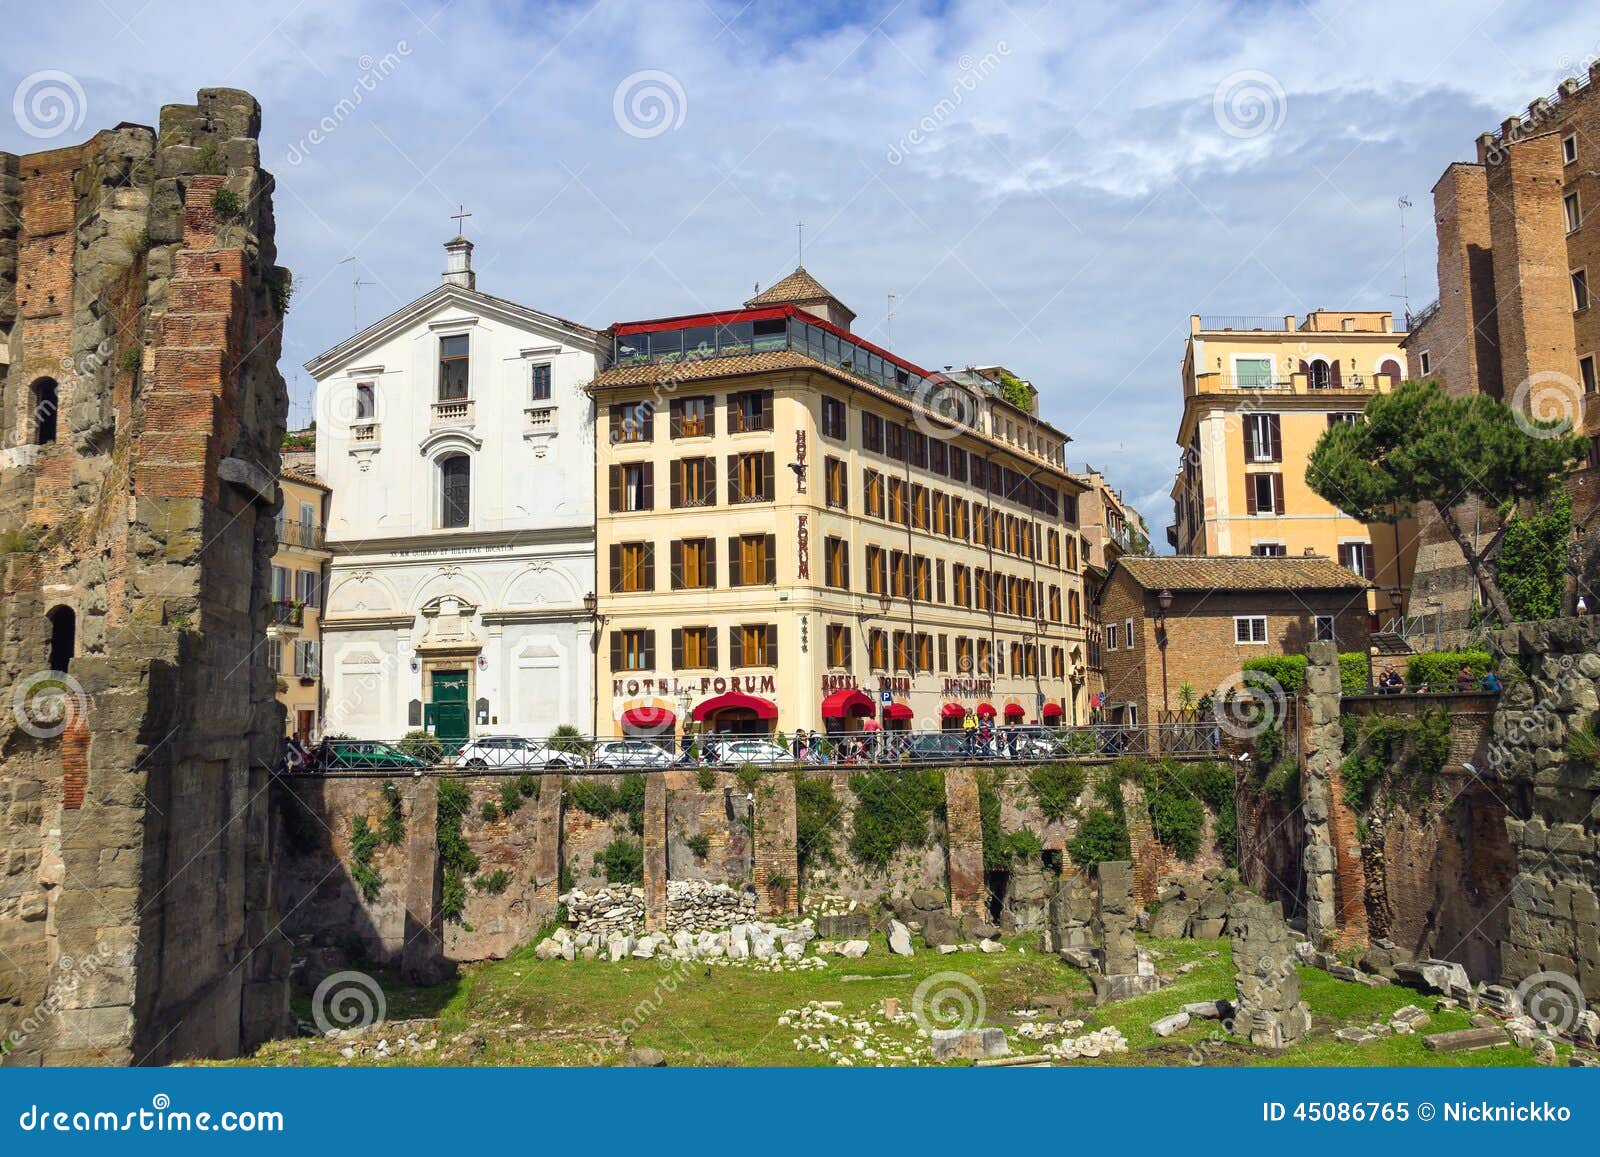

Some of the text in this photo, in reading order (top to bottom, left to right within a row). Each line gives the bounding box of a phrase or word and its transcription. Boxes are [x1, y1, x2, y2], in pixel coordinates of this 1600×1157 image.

[798, 515, 809, 580] FORUM
[613, 675, 776, 697] HOTEL FORUM
[821, 675, 859, 690] HOTEL
[879, 676, 910, 691] FORUM
[883, 692, 890, 701] P
